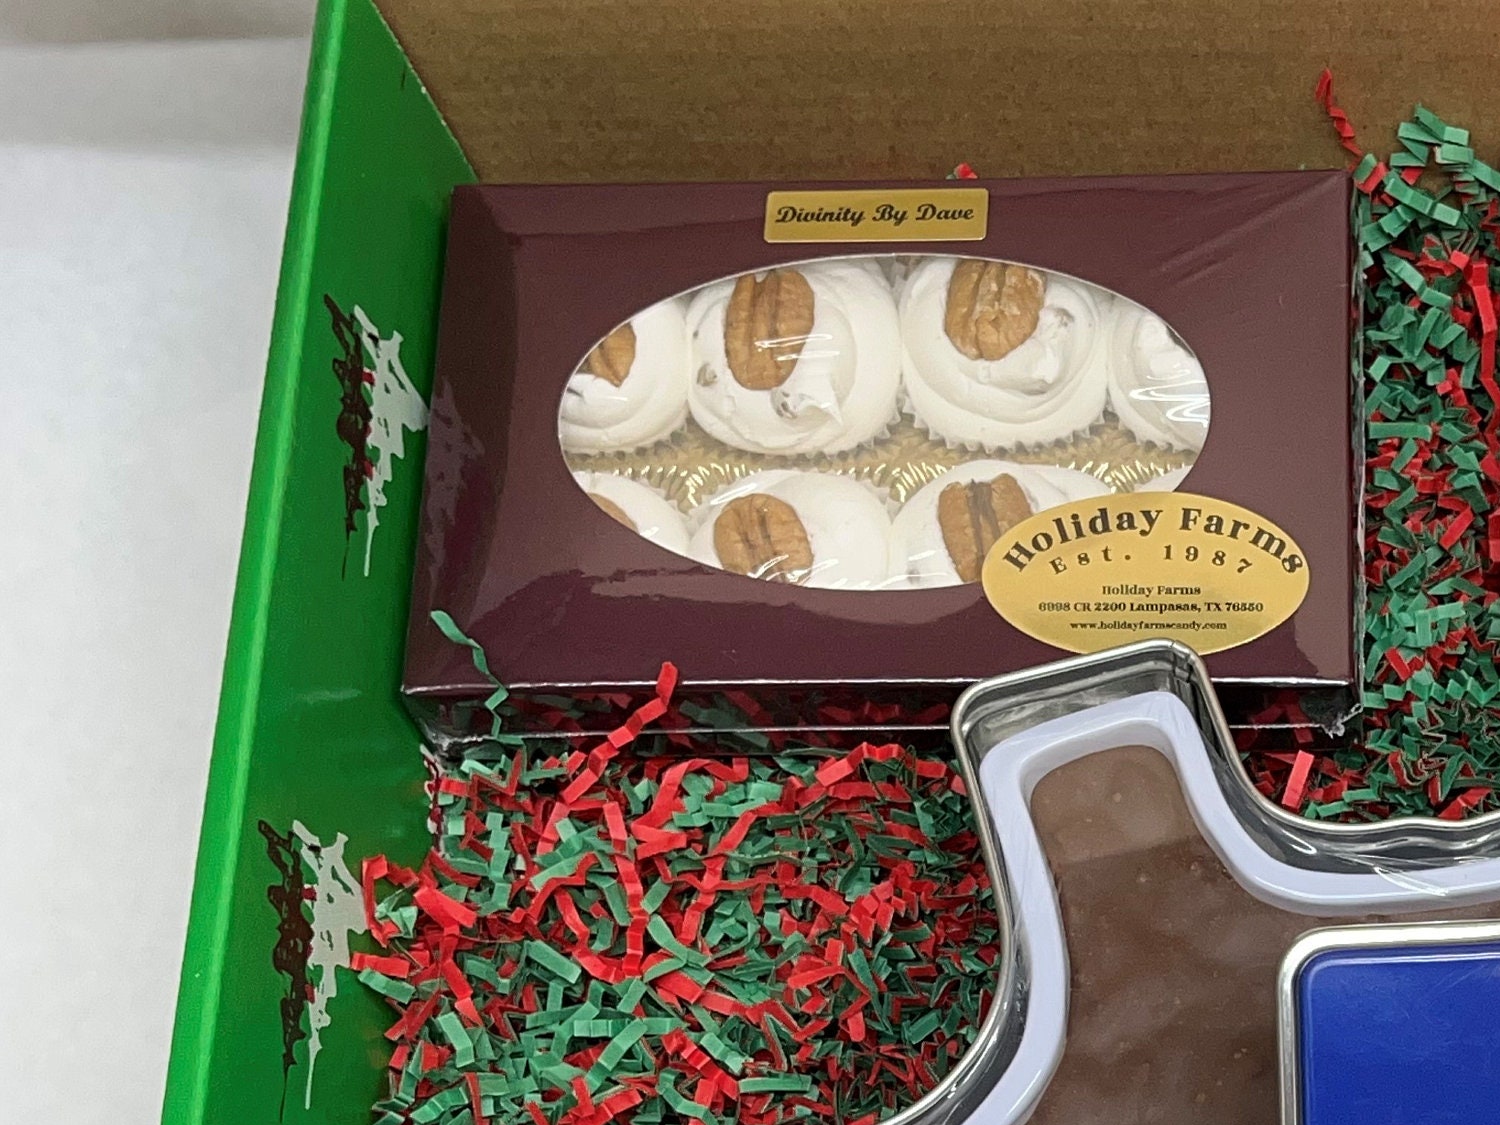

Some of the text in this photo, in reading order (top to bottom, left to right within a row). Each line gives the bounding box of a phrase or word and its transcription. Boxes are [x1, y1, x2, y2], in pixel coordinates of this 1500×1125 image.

[775, 203, 974, 227] Divinity By Dave
[1002, 507, 1303, 574] Holiday Farms
[1163, 544, 1253, 574] 1987
[1101, 585, 1201, 598] Holiday Farms
[1073, 602, 1091, 612] CR
[1094, 602, 1126, 612] 2200
[1129, 602, 1201, 614] Lampasas,
[1204, 602, 1222, 612] TX
[1224, 602, 1264, 612] 76550
[1069, 620, 1228, 631] www.holidayfarmscandy.com
